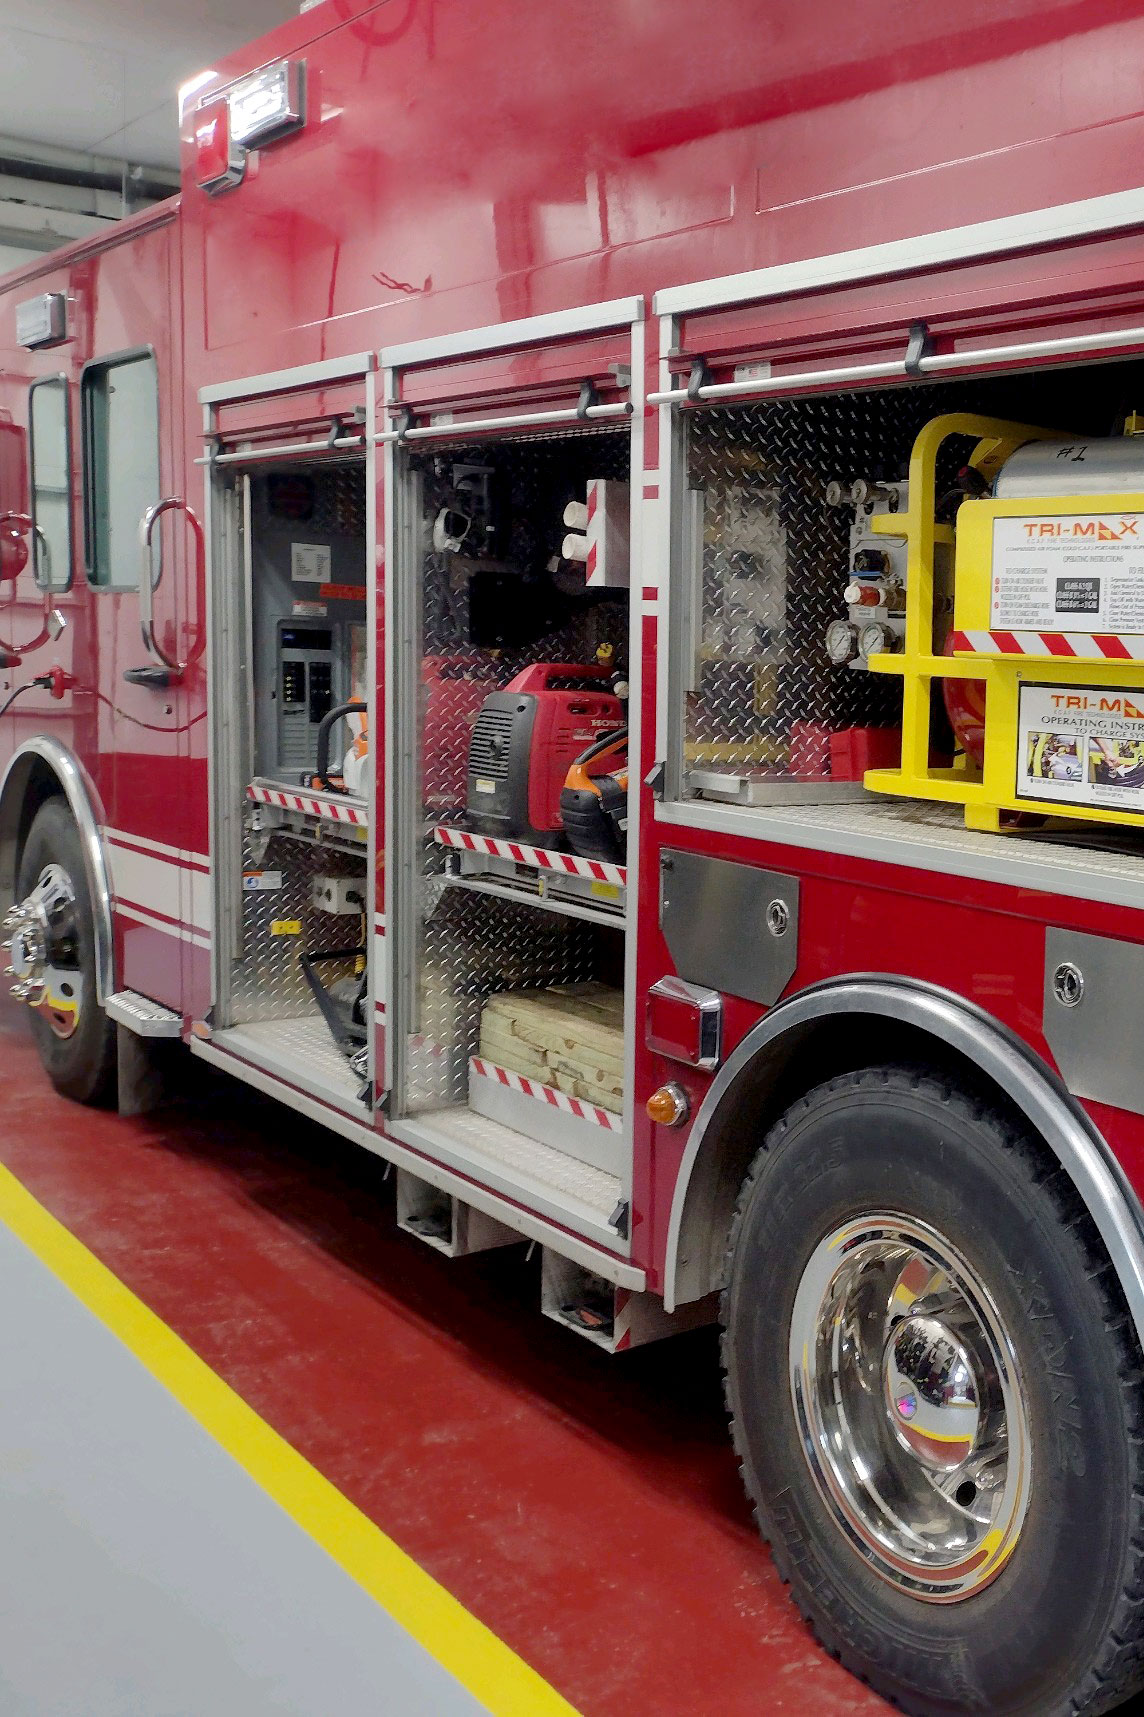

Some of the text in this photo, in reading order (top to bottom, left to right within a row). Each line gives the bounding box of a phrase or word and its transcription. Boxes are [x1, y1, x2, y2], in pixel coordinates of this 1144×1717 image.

[1056, 445, 1089, 462] #1
[590, 719, 628, 727] HOND
[1041, 715, 1107, 729] OPERATING
[1075, 727, 1088, 735] TO
[1089, 728, 1127, 738] CHARGE
